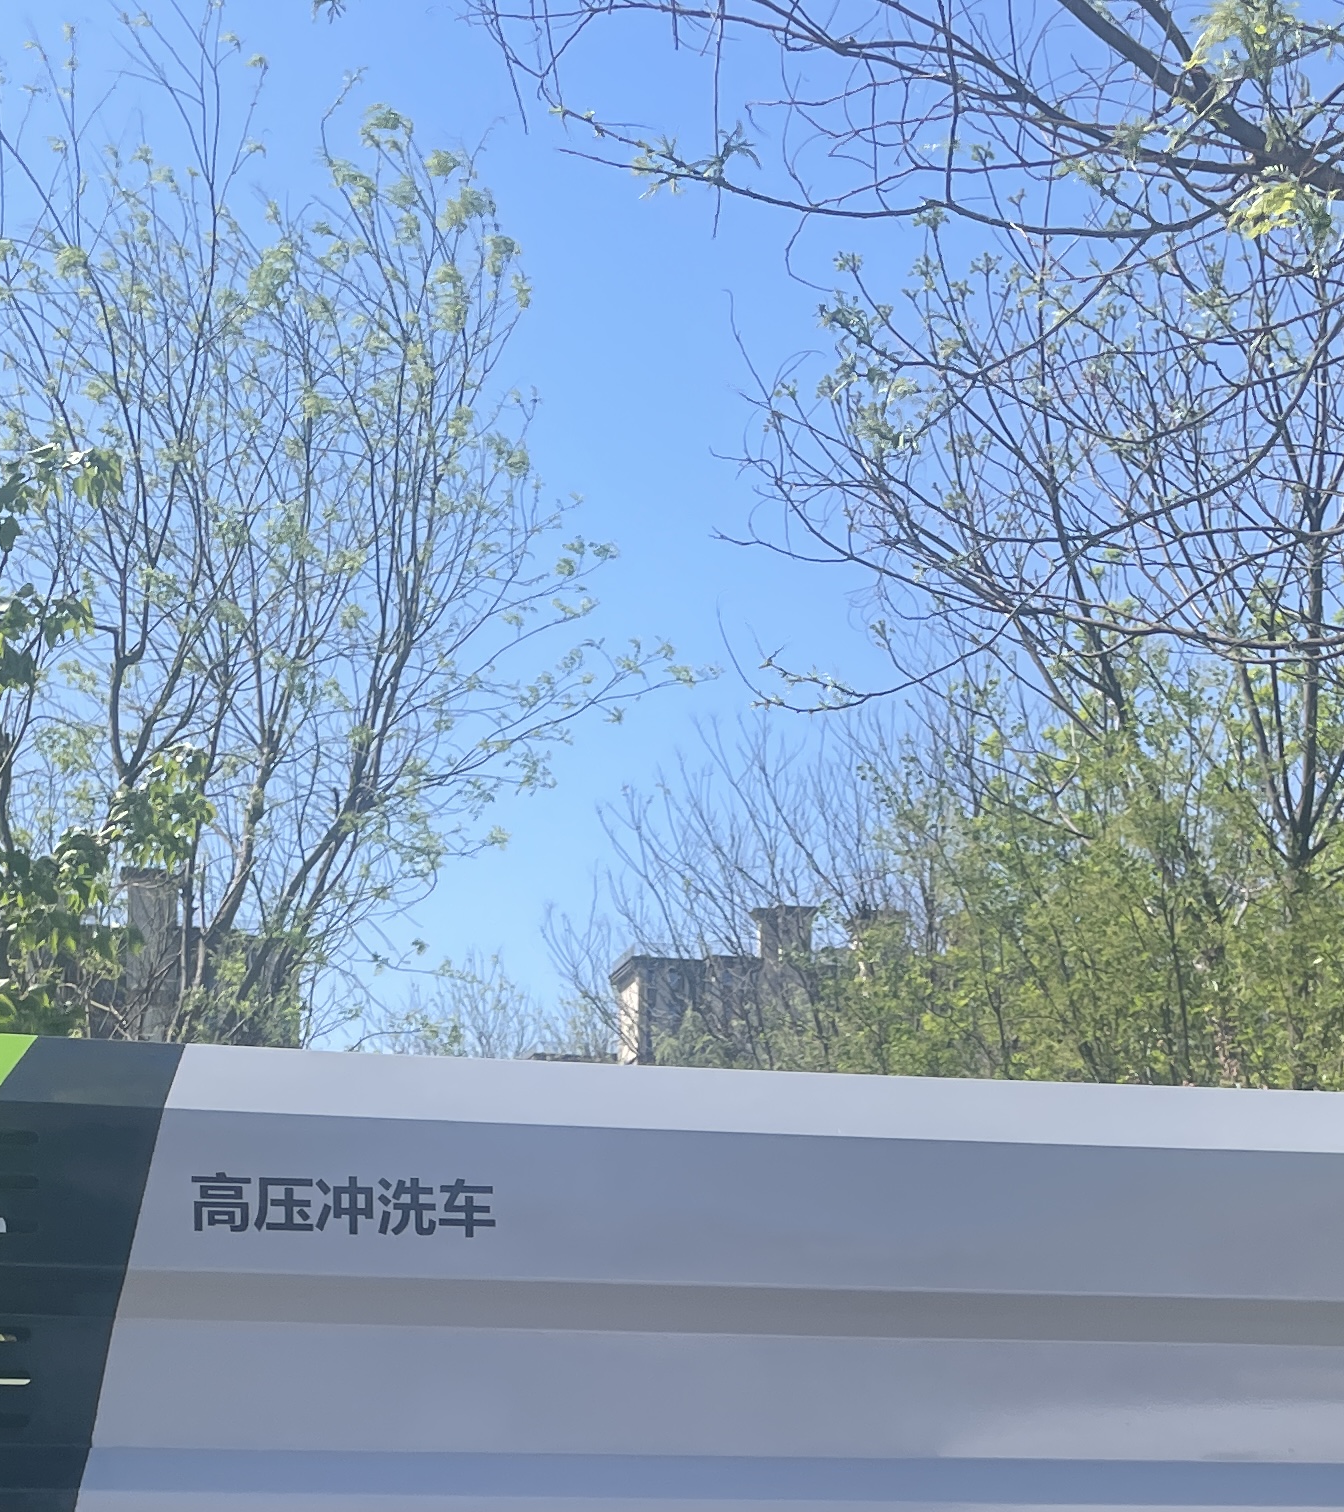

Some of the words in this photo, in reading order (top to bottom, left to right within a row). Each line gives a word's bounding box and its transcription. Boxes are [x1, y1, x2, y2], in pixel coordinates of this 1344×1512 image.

[191, 1172, 496, 1238] 高压冲洗车
